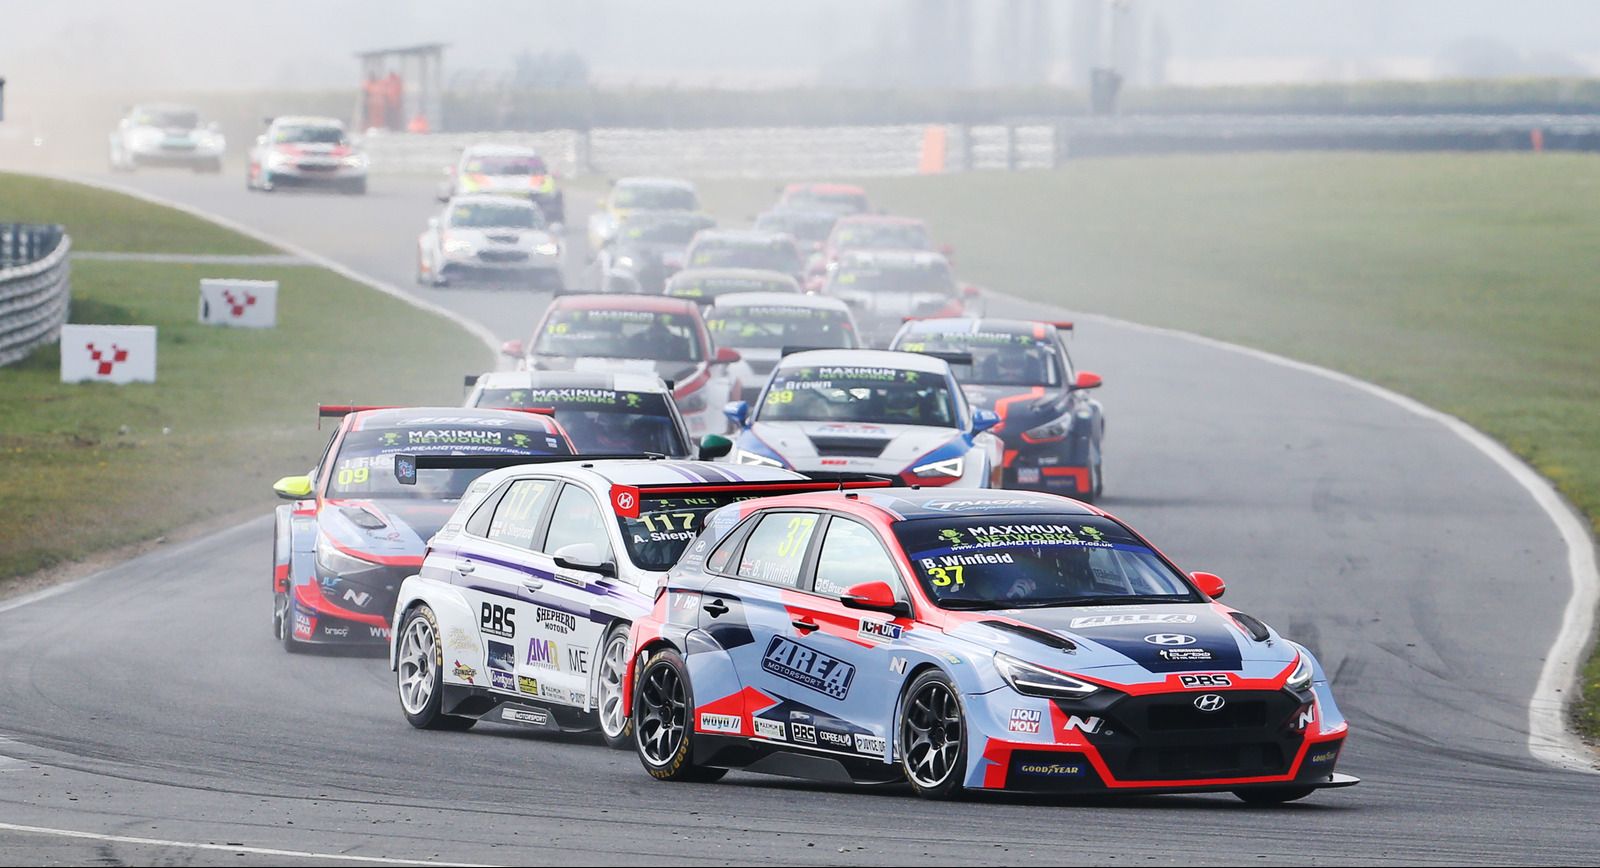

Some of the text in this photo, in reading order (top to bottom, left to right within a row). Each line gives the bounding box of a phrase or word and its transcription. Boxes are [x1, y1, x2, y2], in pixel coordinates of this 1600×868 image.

[820, 367, 896, 376] MAXIMUM
[532, 388, 617, 399] MAXIMUM
[767, 390, 794, 404] 39
[532, 396, 617, 405] NETWORKS
[408, 429, 501, 439] MAXIMUM
[408, 437, 502, 445] NETWORKS
[337, 467, 369, 485] 09
[637, 513, 695, 532] 117
[967, 524, 1074, 537] MAXIMUM
[777, 516, 814, 558] 37
[975, 533, 1079, 544] NETWORKS
[928, 566, 964, 586] 37
[536, 607, 576, 632] SHEPHERD
[545, 622, 568, 634] MOTORS
[768, 639, 848, 687] AREA
[767, 661, 824, 687] MOTORSPORT
[515, 711, 547, 723] MOTORSPORT
[1011, 709, 1041, 721] LIQUI
[1009, 720, 1040, 733] MOLY
[1021, 764, 1079, 775] GOODYEAR
